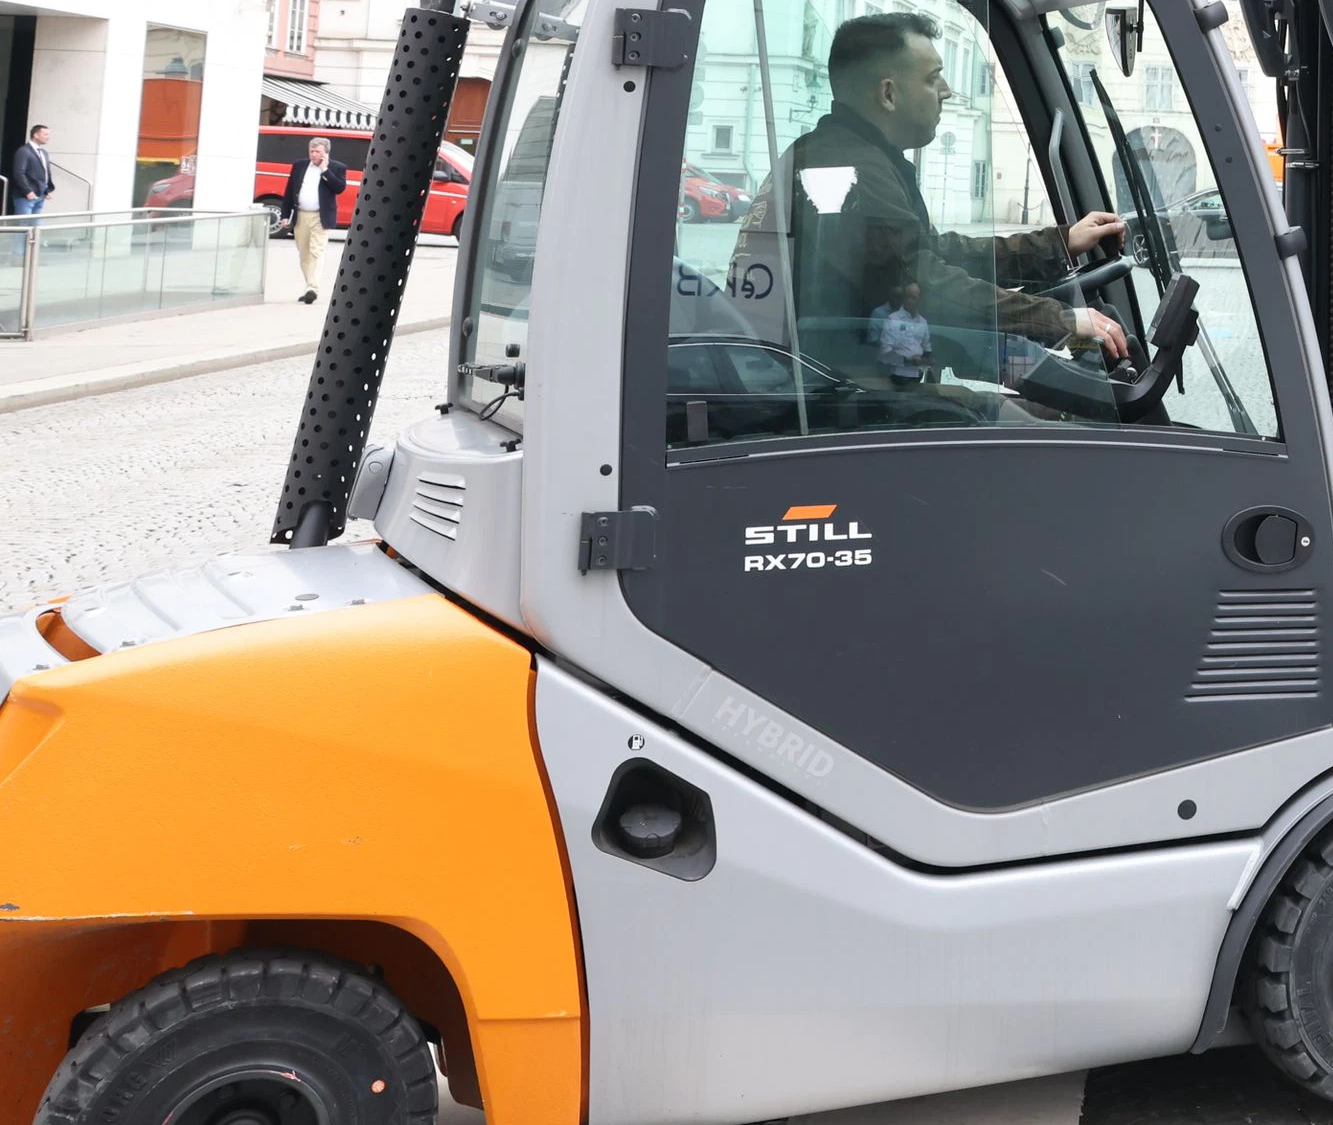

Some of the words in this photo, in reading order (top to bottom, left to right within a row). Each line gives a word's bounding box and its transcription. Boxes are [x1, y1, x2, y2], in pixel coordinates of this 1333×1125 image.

[744, 520, 872, 545] STILL
[744, 548, 872, 572] RX70-35
[715, 695, 835, 778] HYBRID
